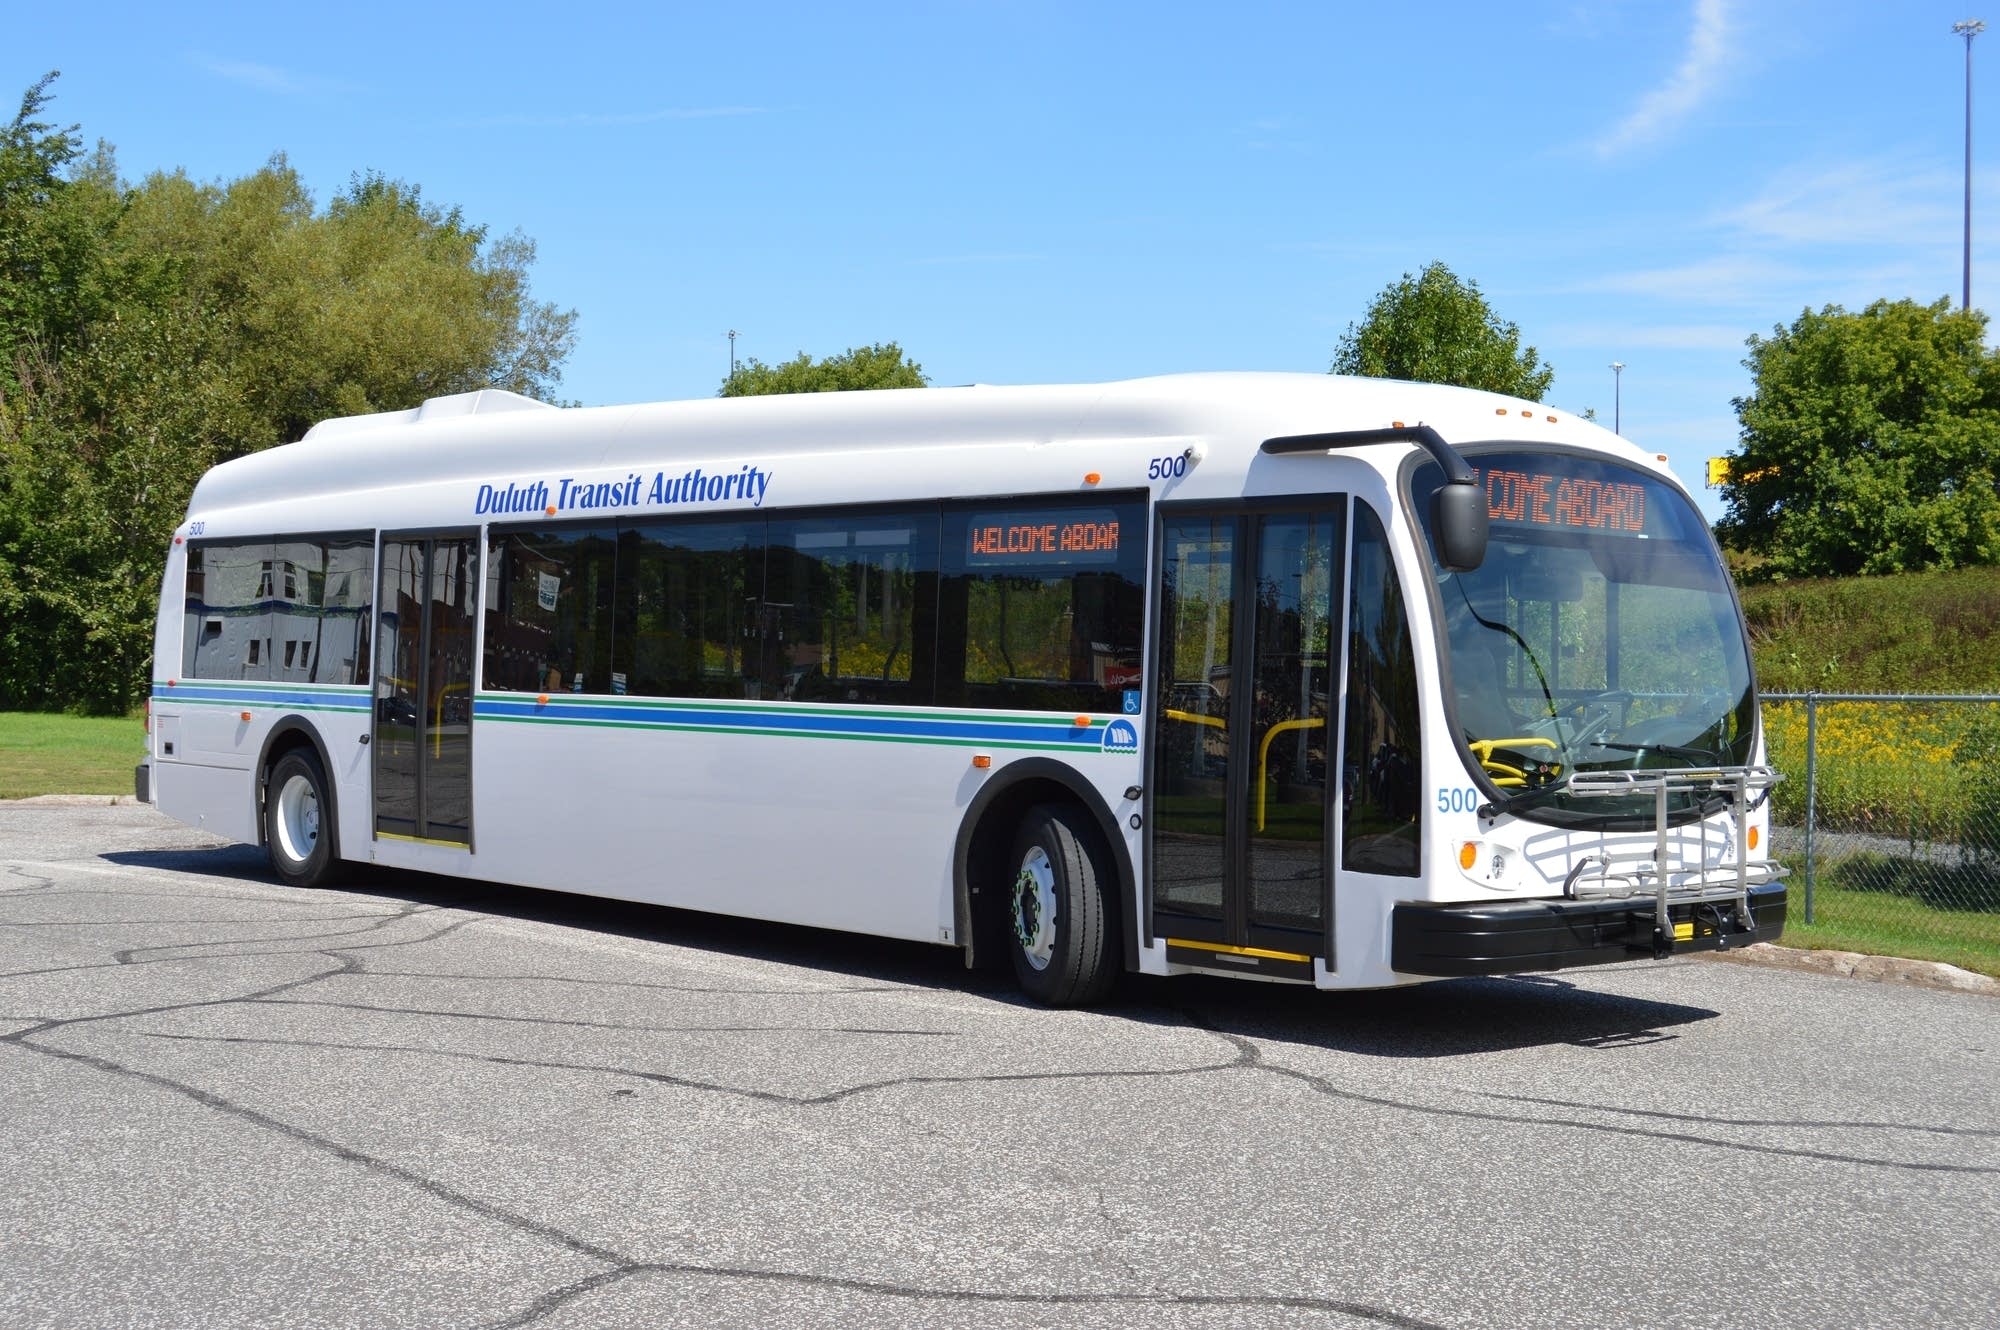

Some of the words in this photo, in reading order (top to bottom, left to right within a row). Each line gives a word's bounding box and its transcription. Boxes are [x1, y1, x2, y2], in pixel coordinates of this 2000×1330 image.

[1148, 455, 1186, 480] 500
[475, 480, 549, 515] Duluth
[558, 473, 643, 511] Transit
[647, 464, 773, 507] Authority
[1473, 467, 1553, 524] COME
[1555, 477, 1646, 532] ABOARD
[189, 521, 205, 536] 500
[972, 524, 1057, 554] WELCOME
[1437, 787, 1478, 813] 500
